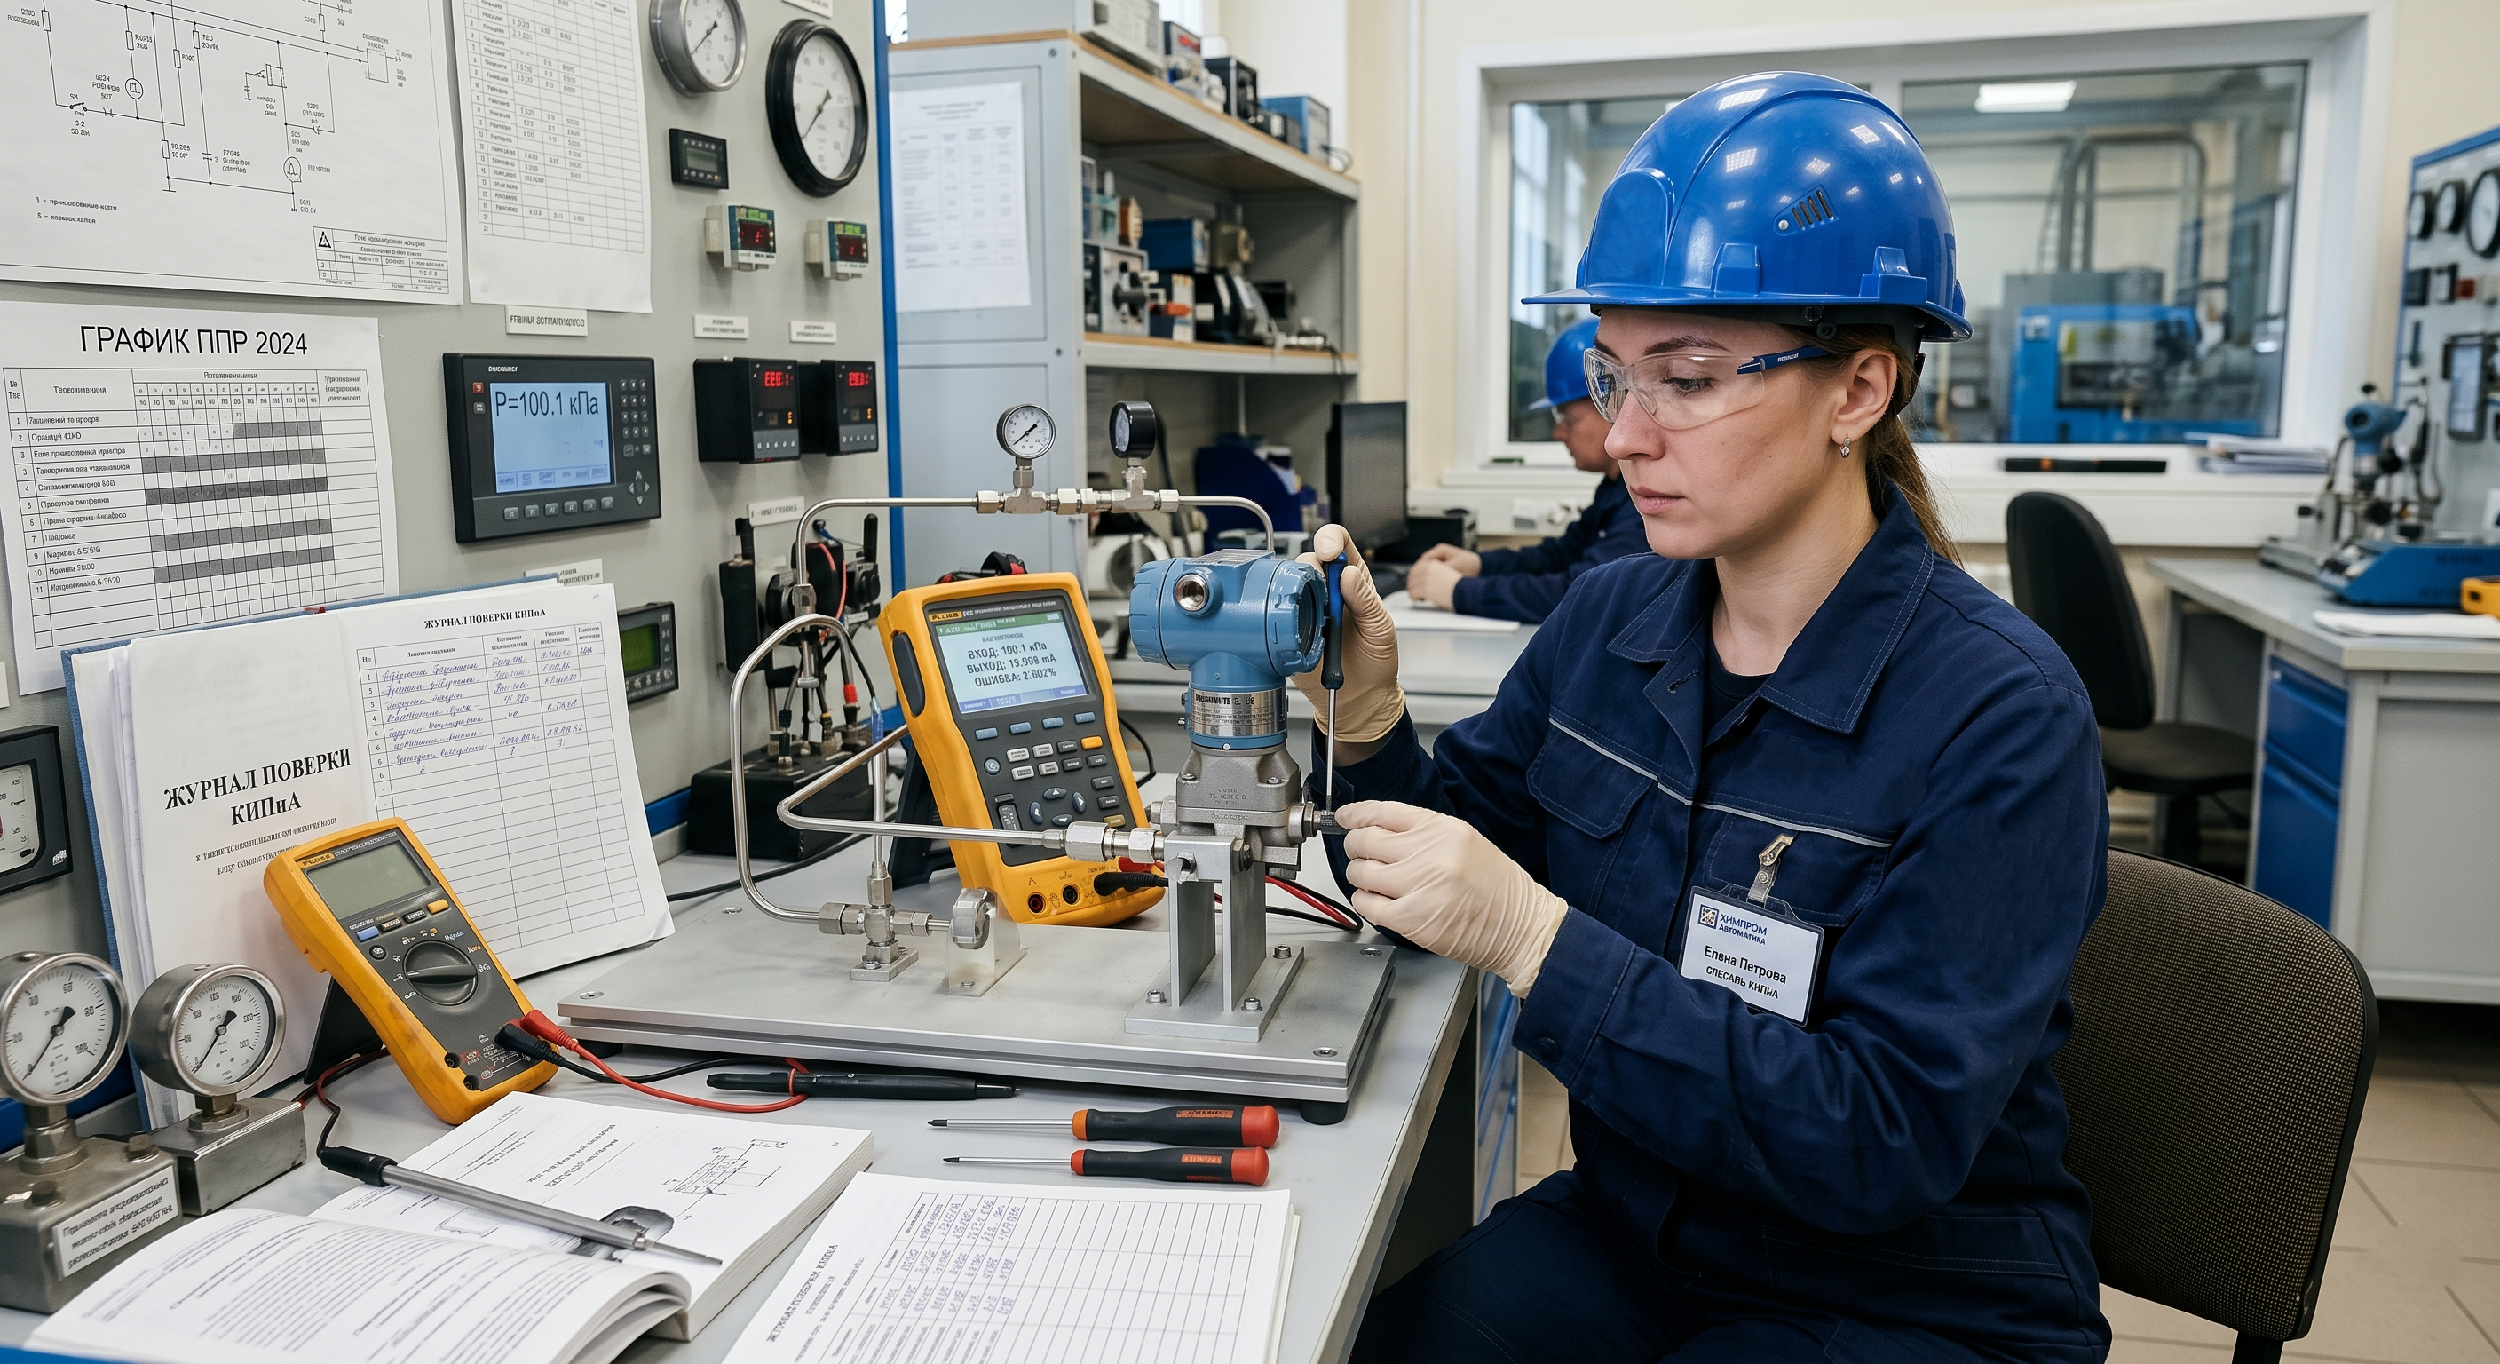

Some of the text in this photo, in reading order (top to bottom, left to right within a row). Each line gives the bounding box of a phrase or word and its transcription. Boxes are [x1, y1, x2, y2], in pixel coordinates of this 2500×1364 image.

[80, 325, 308, 355] ГРАФИК ППР 2024
[569, 390, 599, 416] кПа
[163, 747, 352, 811] ЖУРНАЛ ПОВЕРКИ
[230, 791, 302, 827] КИПиА
[1739, 956, 1787, 984] Петрова
